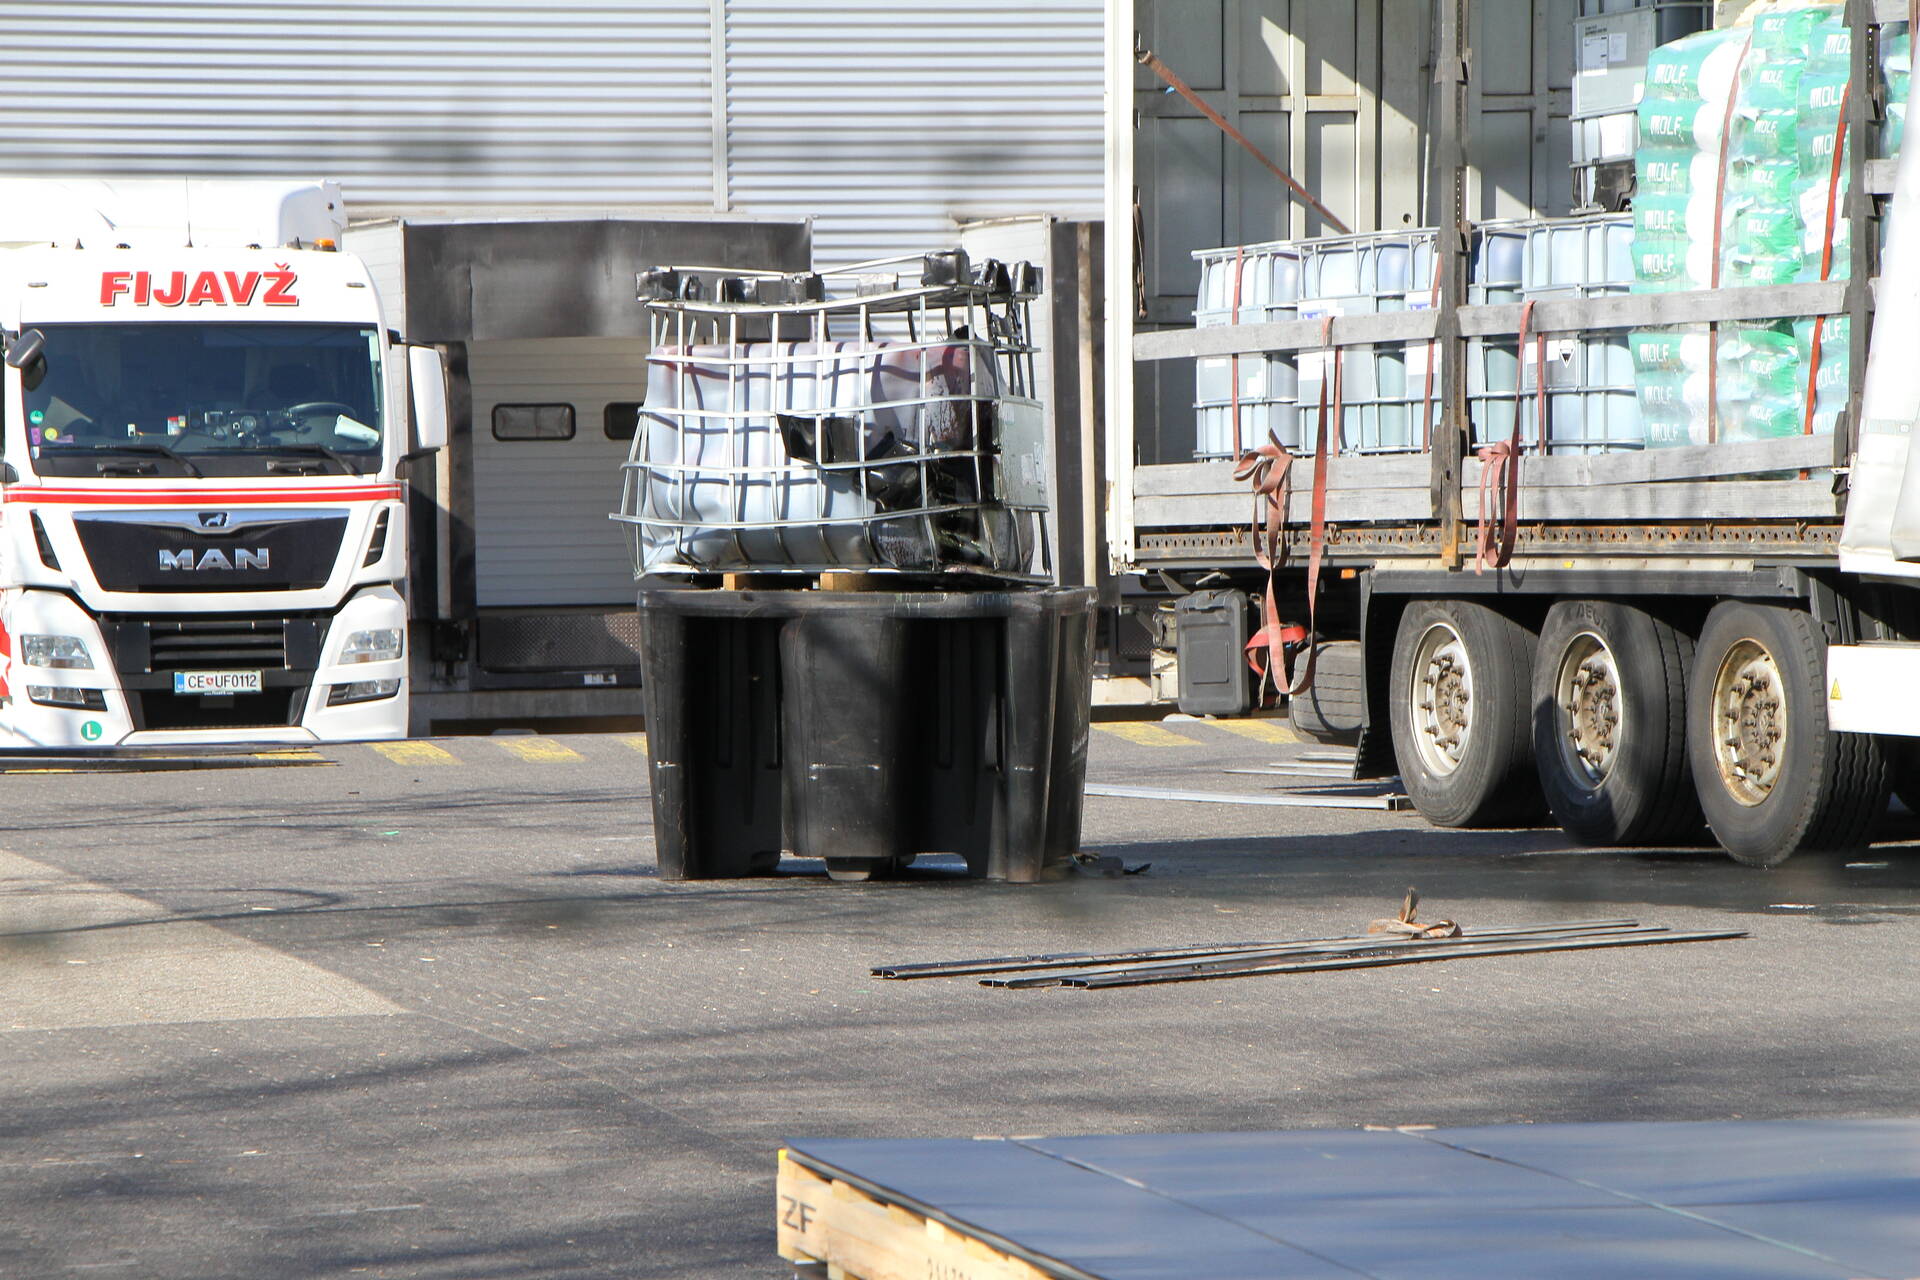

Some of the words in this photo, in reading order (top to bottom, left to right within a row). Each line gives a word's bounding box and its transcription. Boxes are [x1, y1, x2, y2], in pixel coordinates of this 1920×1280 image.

[100, 262, 299, 306] FIJAVŽ
[158, 547, 270, 571] MAN
[188, 674, 207, 689] CE
[214, 673, 257, 689] UF0112
[86, 723, 97, 739] L
[780, 1195, 817, 1233] ZF
